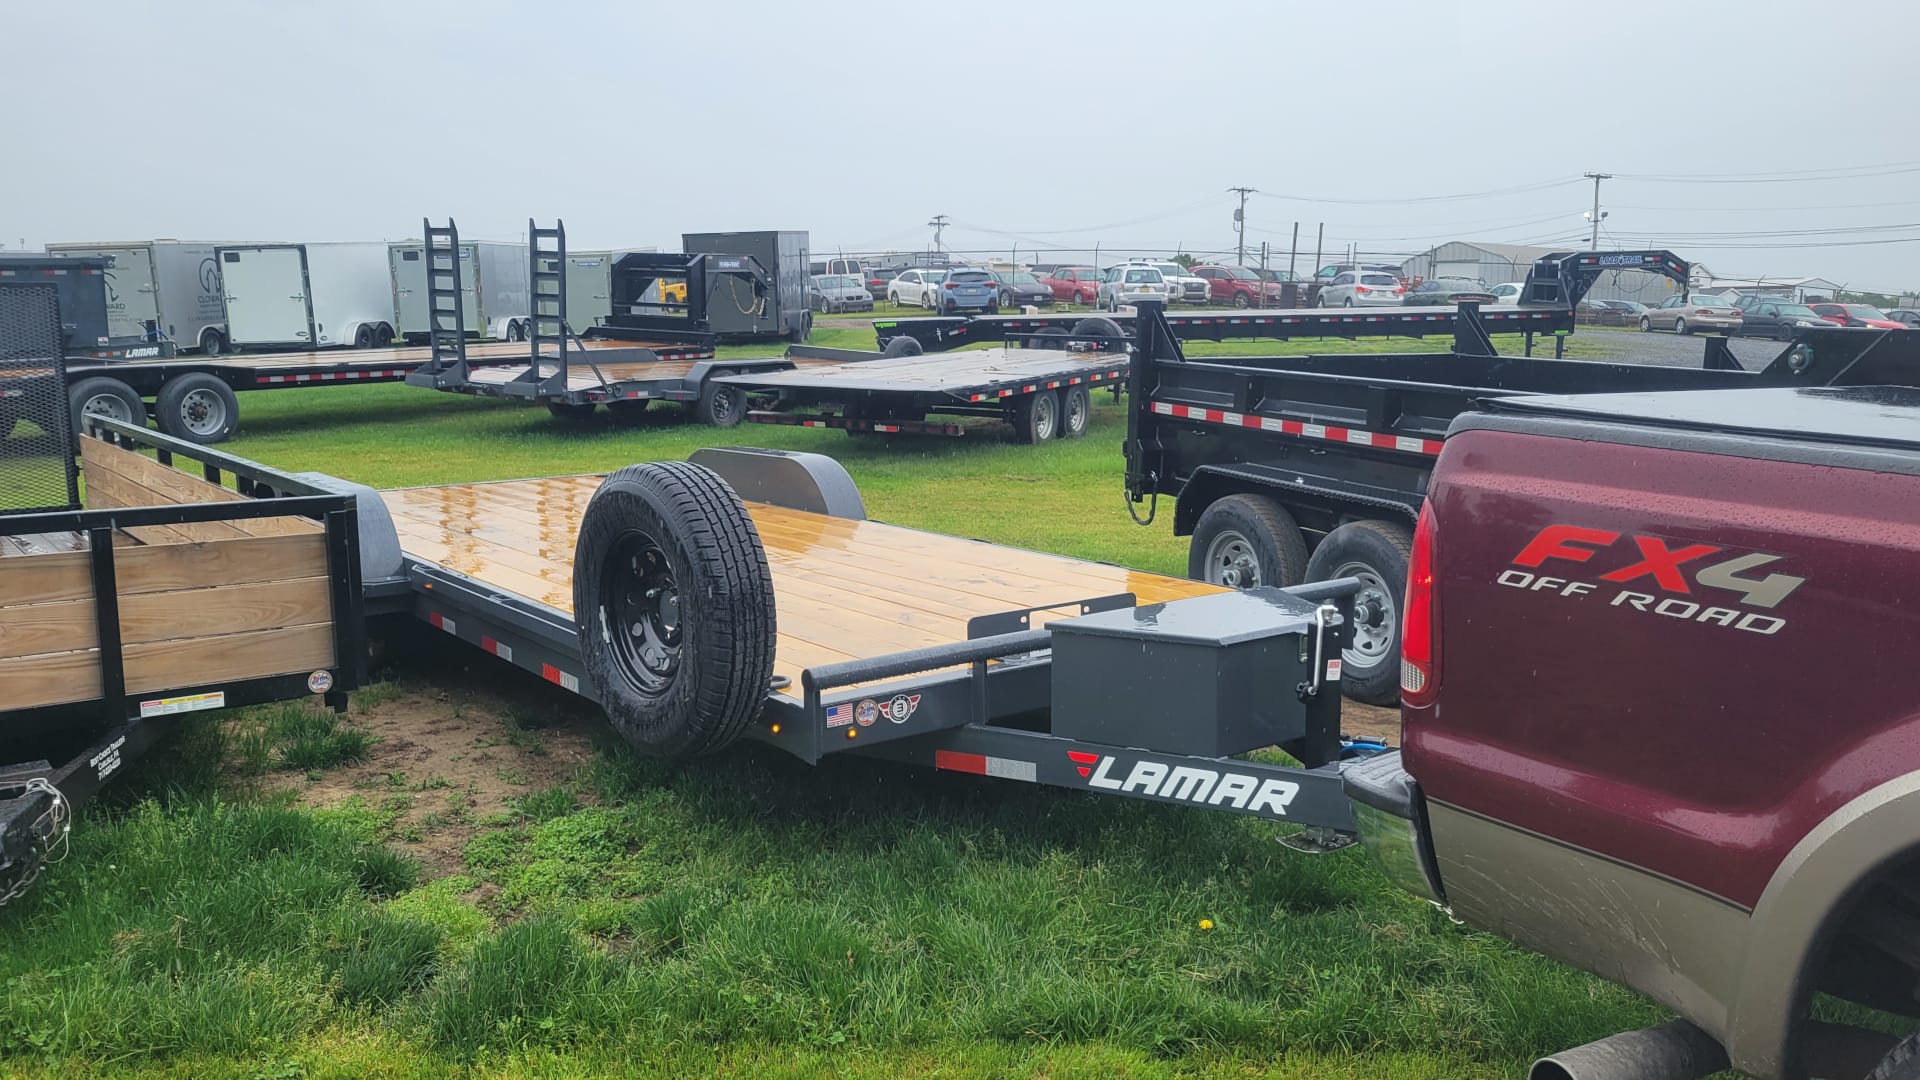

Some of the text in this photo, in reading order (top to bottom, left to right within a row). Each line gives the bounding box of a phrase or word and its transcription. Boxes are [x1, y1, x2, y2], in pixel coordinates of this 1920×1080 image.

[1599, 256, 1619, 265] LOAD
[125, 347, 159, 358] LAMAR
[1511, 523, 1807, 609] FX4
[1497, 569, 1787, 636] OFF ROAD
[1088, 755, 1301, 816] LAMAR
